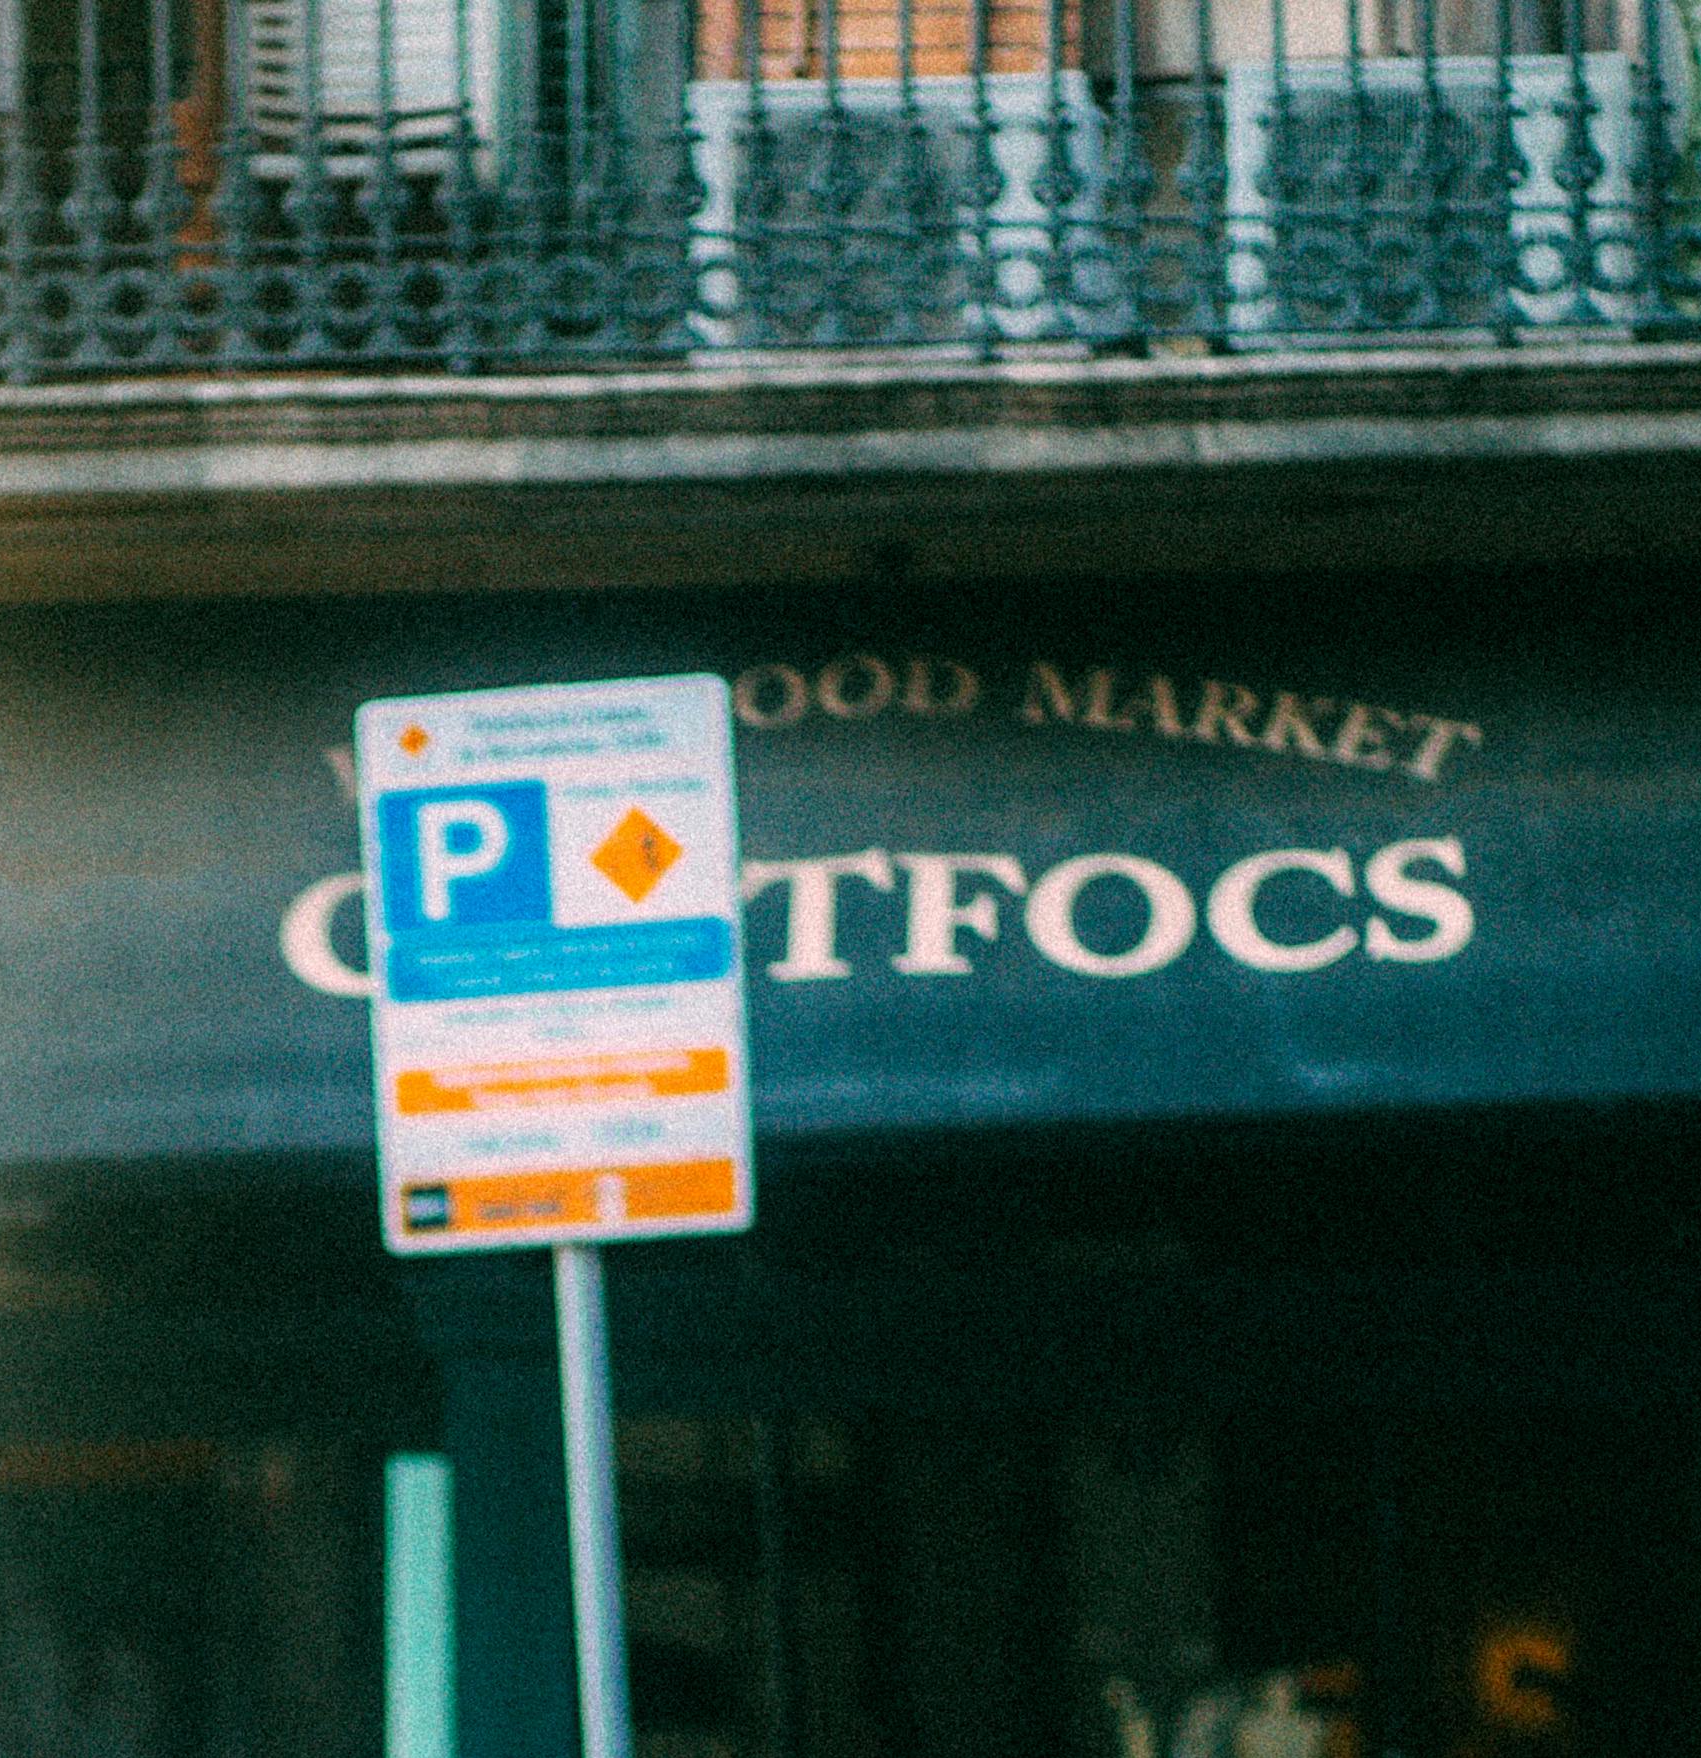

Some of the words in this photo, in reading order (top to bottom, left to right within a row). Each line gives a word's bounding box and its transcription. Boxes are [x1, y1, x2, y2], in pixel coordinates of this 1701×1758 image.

[730, 655, 980, 729] OOD
[1022, 661, 1485, 783] MARKET
[280, 835, 1477, 999] CTFOCS
[416, 798, 509, 922] P
